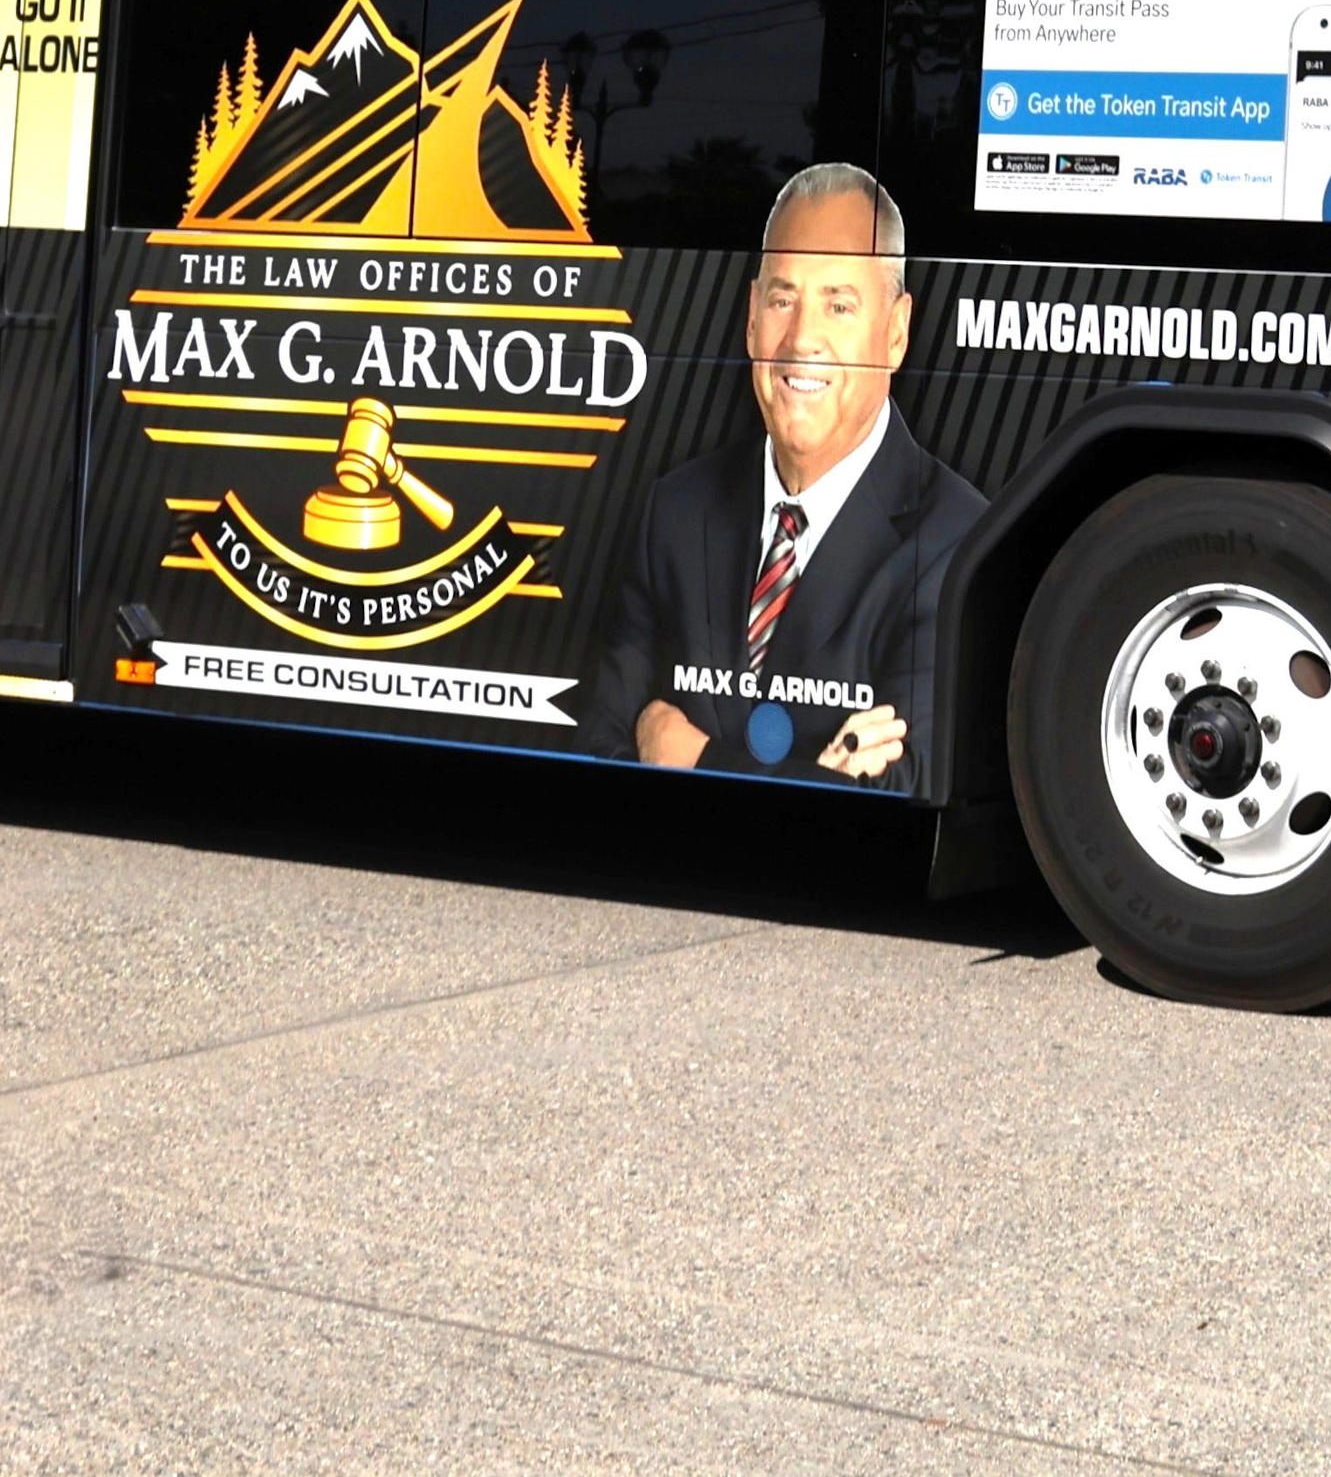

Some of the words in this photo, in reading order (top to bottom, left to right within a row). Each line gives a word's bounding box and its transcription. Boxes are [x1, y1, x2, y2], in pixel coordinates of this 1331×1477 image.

[1028, 0, 1065, 17] Your
[1130, 0, 1170, 18] Pass
[994, 23, 1031, 42] from
[1035, 24, 1117, 46] Anywhere
[0, 34, 99, 73] ALONE
[1027, 91, 1060, 115] Get
[1065, 93, 1096, 116] the
[1101, 93, 1156, 117] Token
[1161, 94, 1227, 118] Transit
[1230, 96, 1271, 124] App
[1302, 97, 1329, 108] RABA
[1006, 161, 1023, 173] App
[1024, 161, 1046, 172] Store
[1074, 162, 1101, 175] Google
[1101, 162, 1117, 175] Play
[1133, 167, 1188, 186] RABA
[180, 253, 246, 286] THE
[263, 256, 338, 289] LAW
[359, 260, 513, 296] OFFICES
[533, 265, 581, 298] OF
[108, 309, 258, 383] MAX
[278, 320, 335, 384] G.
[351, 326, 648, 407] ARNOLD
[216, 521, 251, 571] TO
[256, 560, 292, 603] US
[298, 585, 352, 626] IT'S
[362, 540, 509, 626] PERSONAL
[183, 654, 265, 685] FREE
[272, 660, 535, 710] CONSULTATION
[673, 664, 733, 696] MAX
[738, 669, 764, 699] G.
[769, 674, 875, 711] ARNOLD
